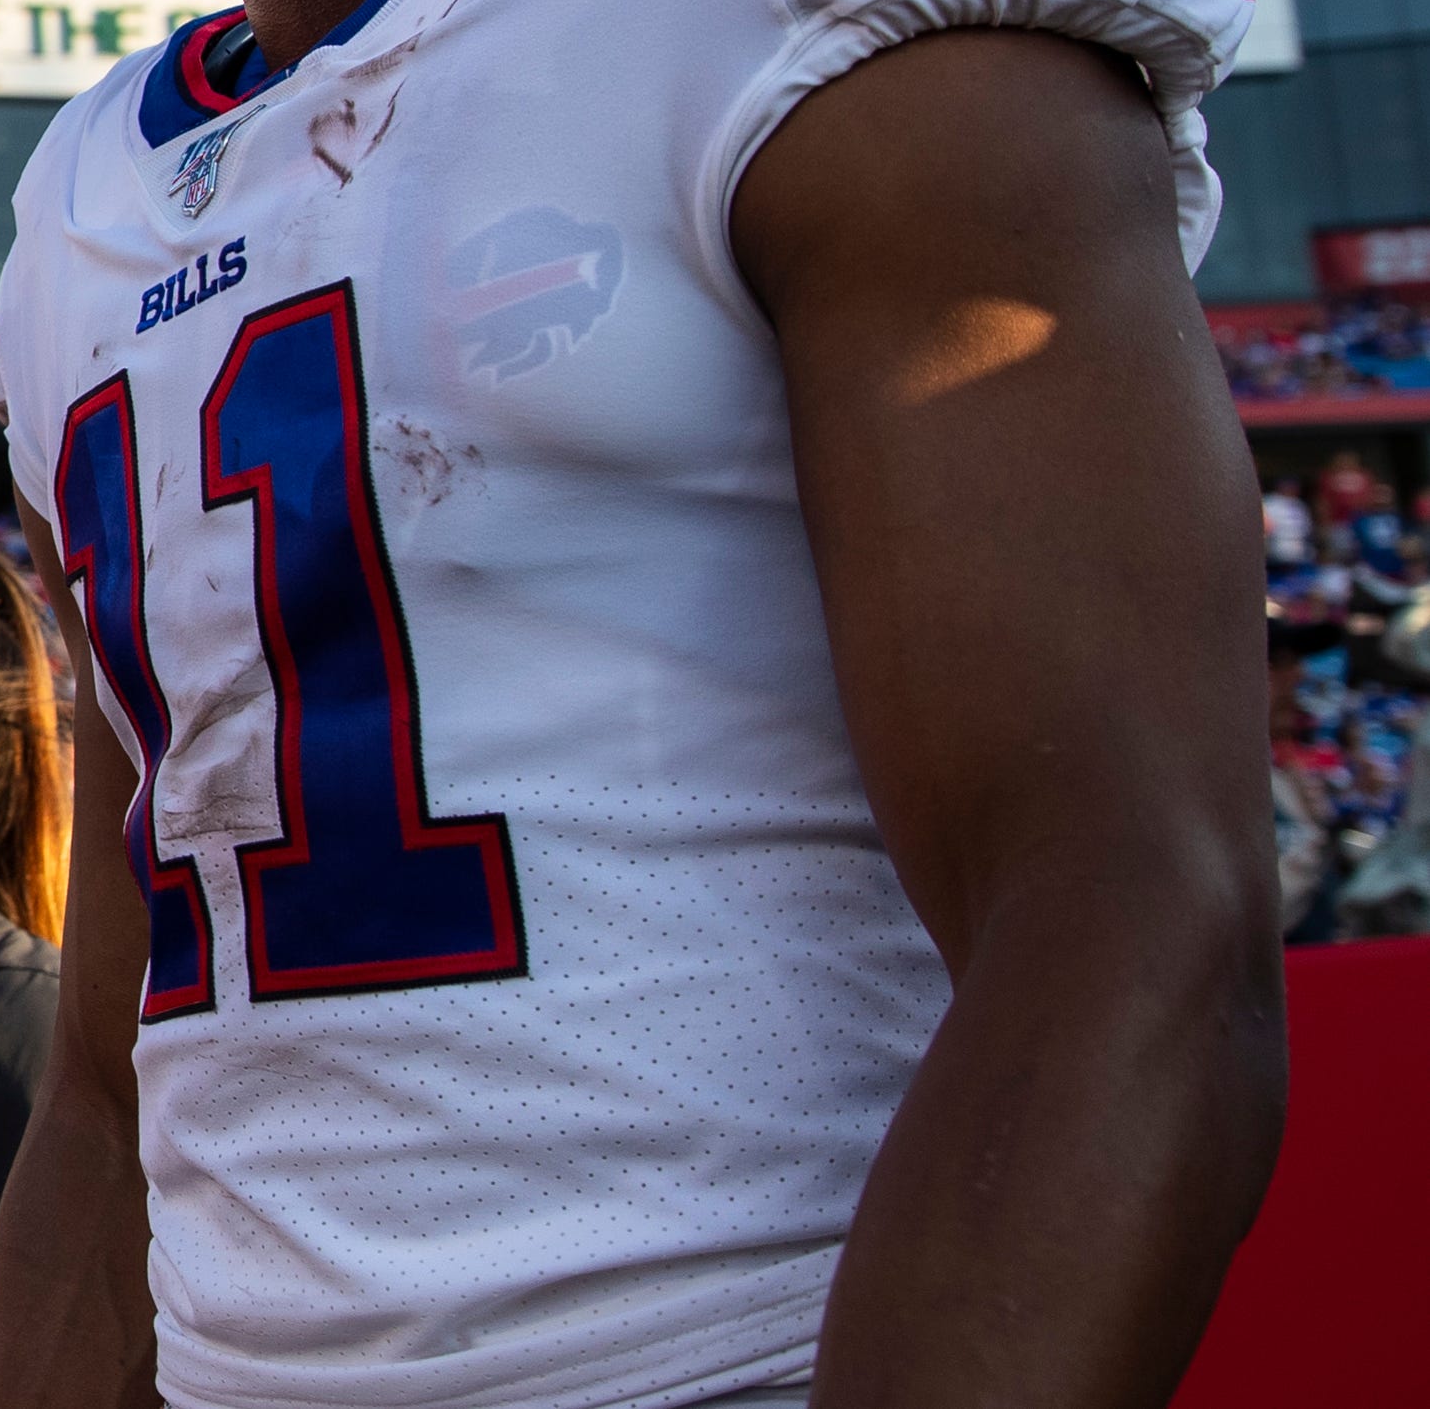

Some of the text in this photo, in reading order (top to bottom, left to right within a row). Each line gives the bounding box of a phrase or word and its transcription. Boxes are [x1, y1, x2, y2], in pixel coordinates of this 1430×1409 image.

[23, 4, 143, 58] THE
[135, 235, 248, 335] BILLS
[54, 276, 530, 1025] 11
